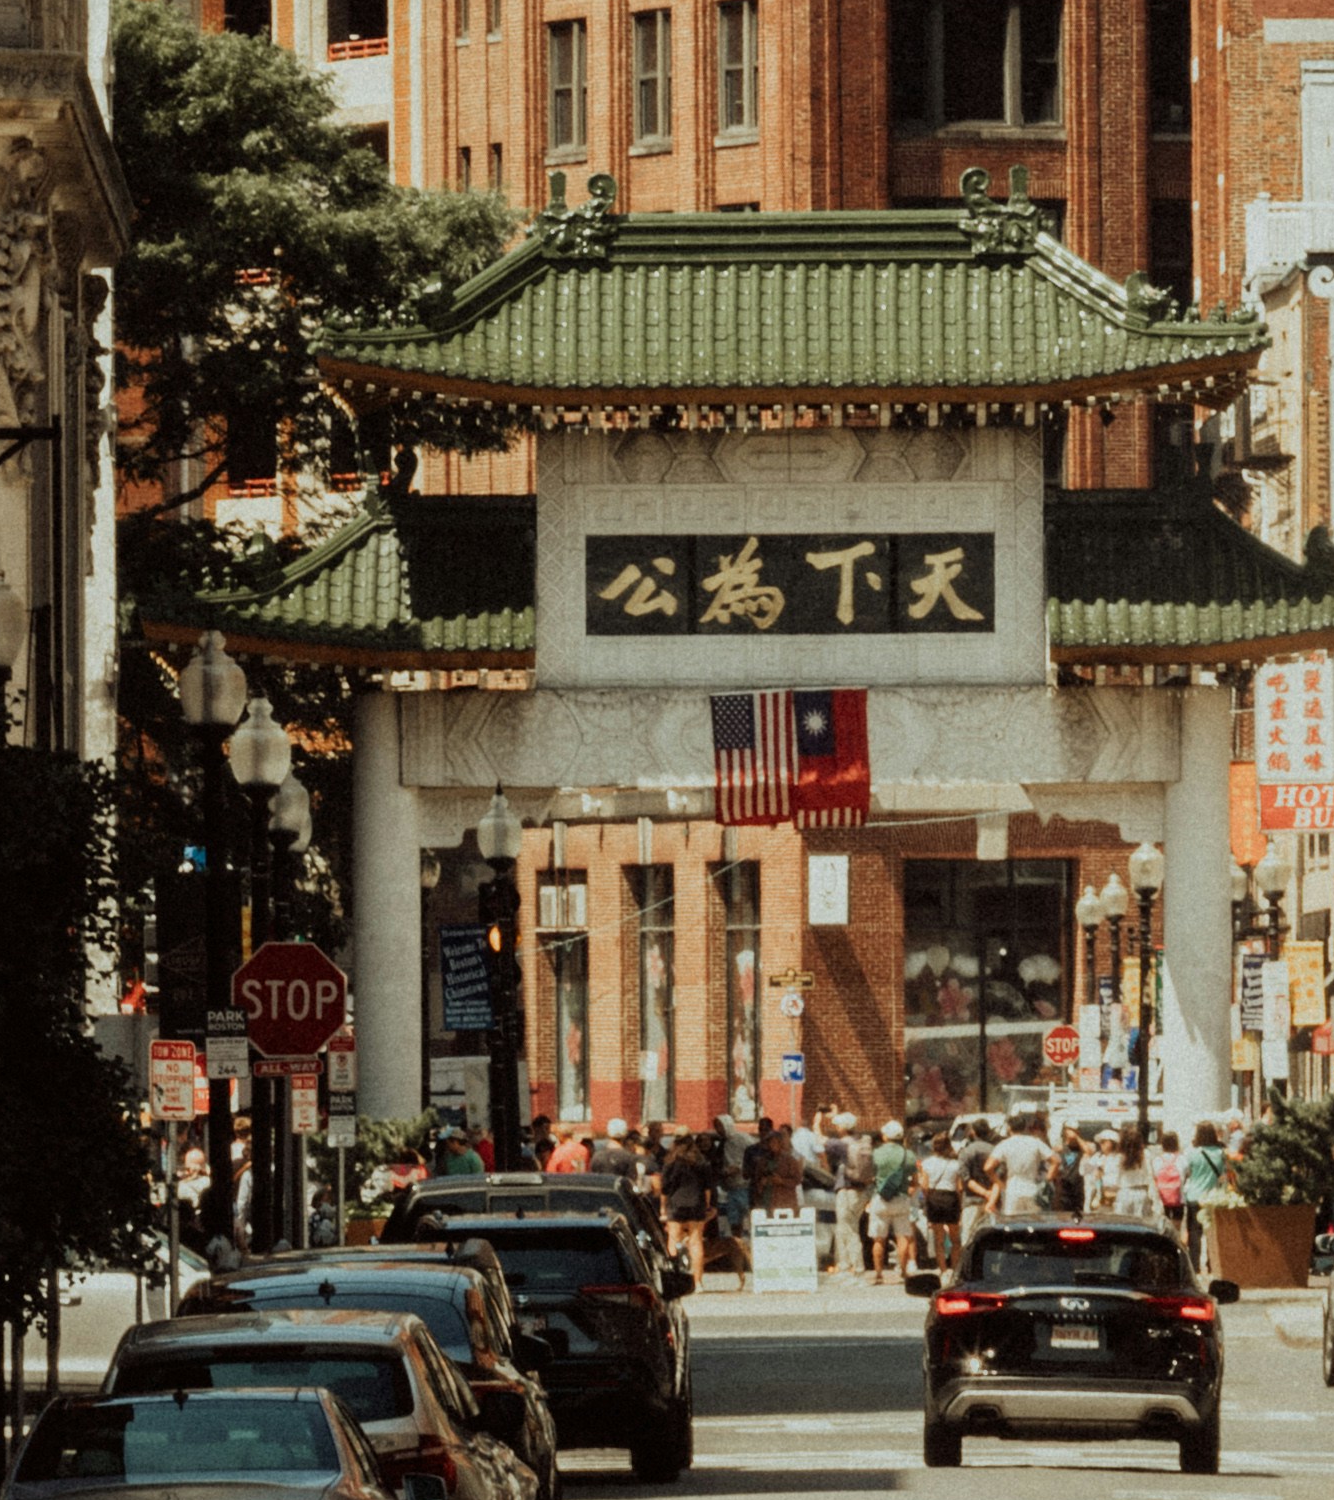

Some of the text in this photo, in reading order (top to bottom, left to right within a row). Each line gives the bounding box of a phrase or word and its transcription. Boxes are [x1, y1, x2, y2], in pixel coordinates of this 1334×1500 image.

[242, 979, 338, 1020] STOP
[207, 1010, 244, 1022] PARK
[1046, 1037, 1078, 1053] STOP
